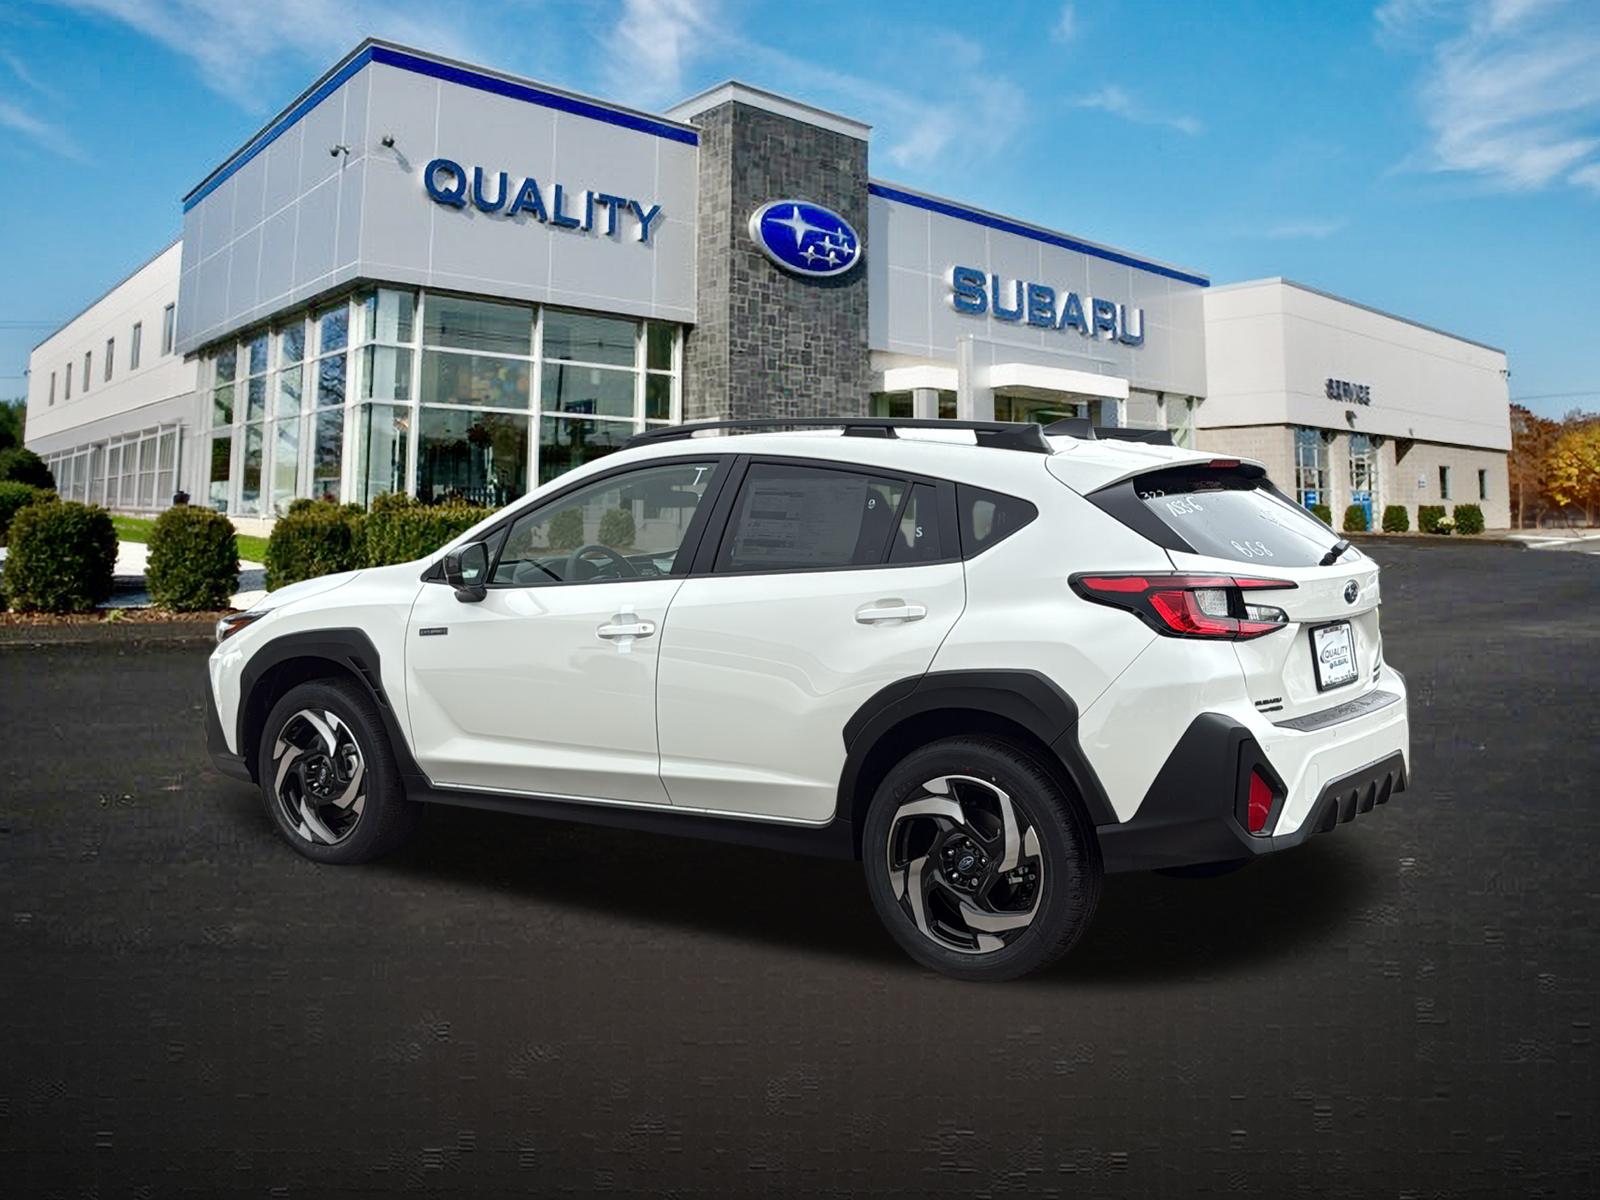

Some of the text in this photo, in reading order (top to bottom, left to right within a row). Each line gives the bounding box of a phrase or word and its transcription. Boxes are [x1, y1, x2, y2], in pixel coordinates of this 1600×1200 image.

[424, 158, 661, 243] QUALITY
[948, 265, 1145, 346] SUBARU
[1325, 378, 1371, 407] SERVICE
[1325, 645, 1348, 659] QUALITY
